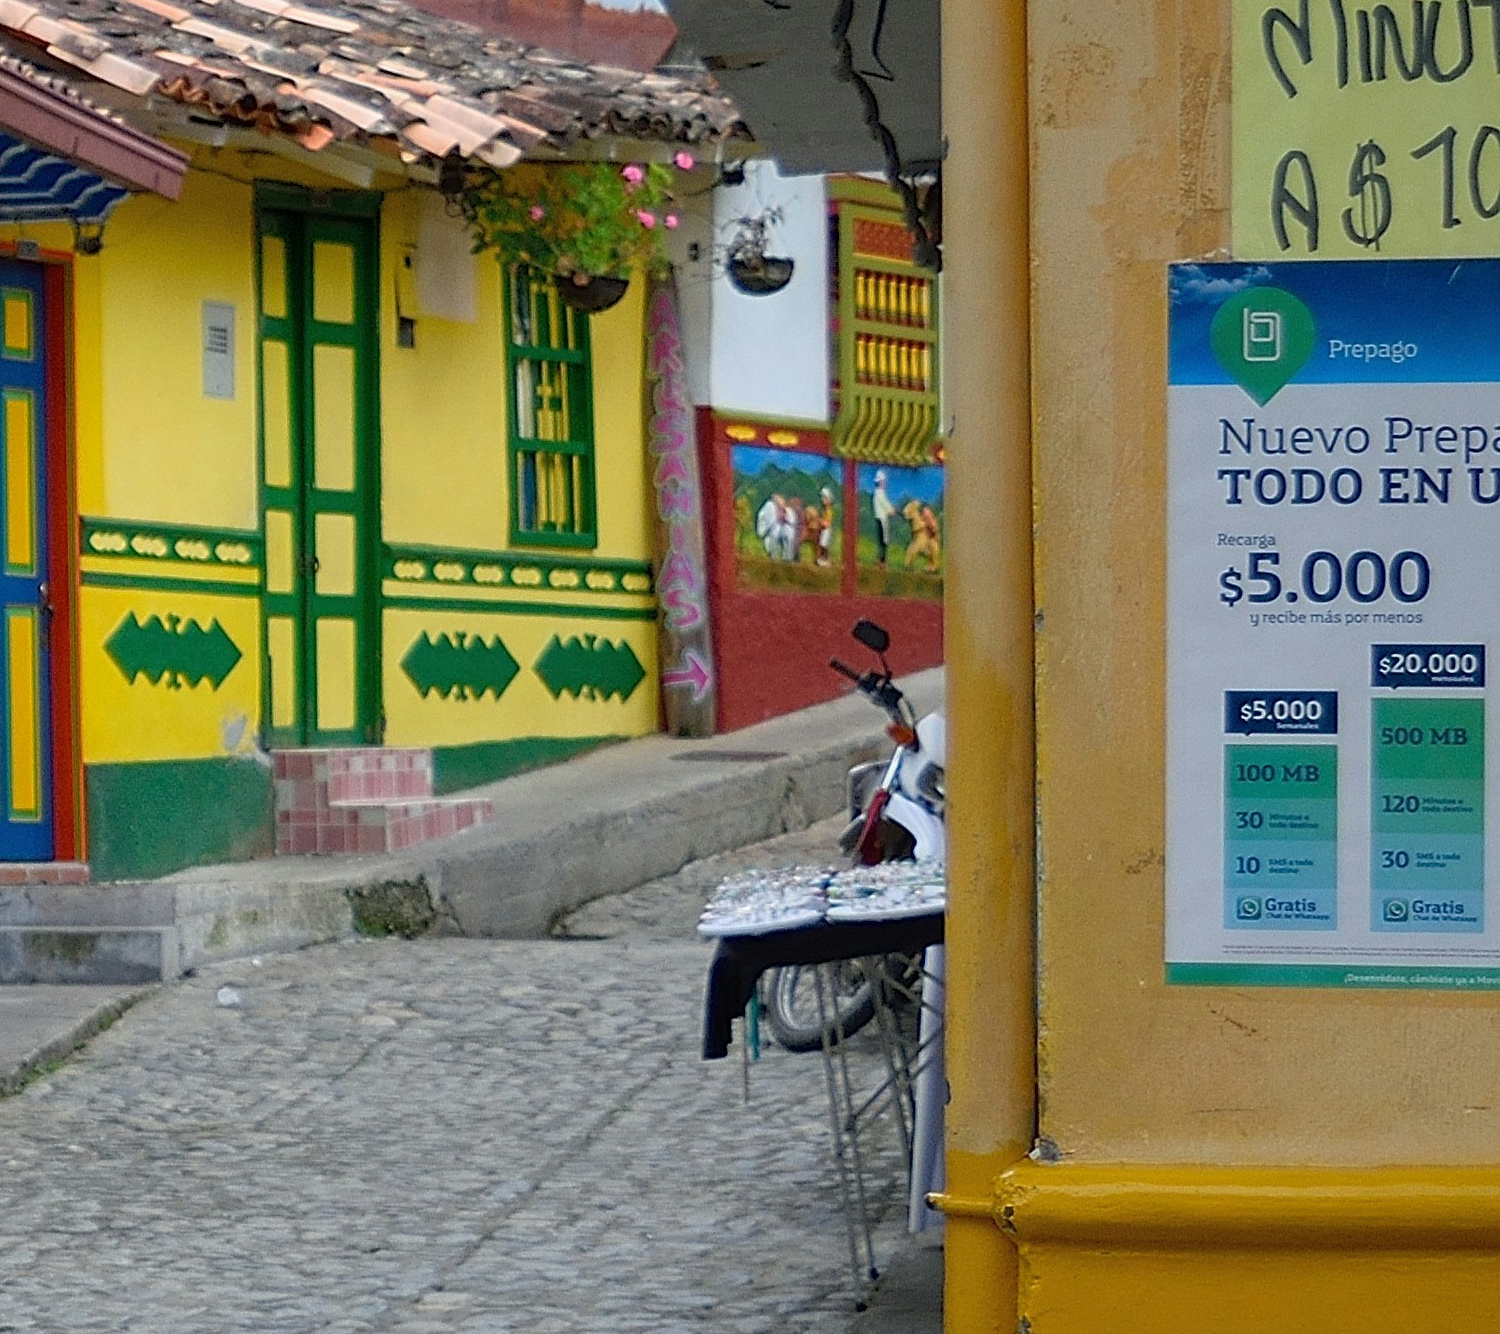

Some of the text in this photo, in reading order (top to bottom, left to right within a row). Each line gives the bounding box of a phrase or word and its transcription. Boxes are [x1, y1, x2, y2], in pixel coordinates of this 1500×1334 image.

[1329, 340, 1417, 363] Prepago
[1219, 418, 1369, 455] Nuevo
[1217, 468, 1362, 505] TODO
[1378, 467, 1452, 504] EN
[1217, 533, 1276, 549] Recarga
[1219, 550, 1431, 607] $5.000
[1250, 610, 1422, 627] y recibe más por menos
[1379, 653, 1477, 675] $20.000
[1240, 700, 1322, 721] $5.000
[1381, 727, 1468, 745] 500 MB
[1236, 764, 1320, 782] 100 MB
[1382, 795, 1420, 813] 120
[1236, 811, 1263, 829] 30
[1236, 856, 1260, 874] 10
[1381, 851, 1410, 869] 30
[1265, 898, 1317, 912] Gratis
[1412, 900, 1465, 914] Gratis
